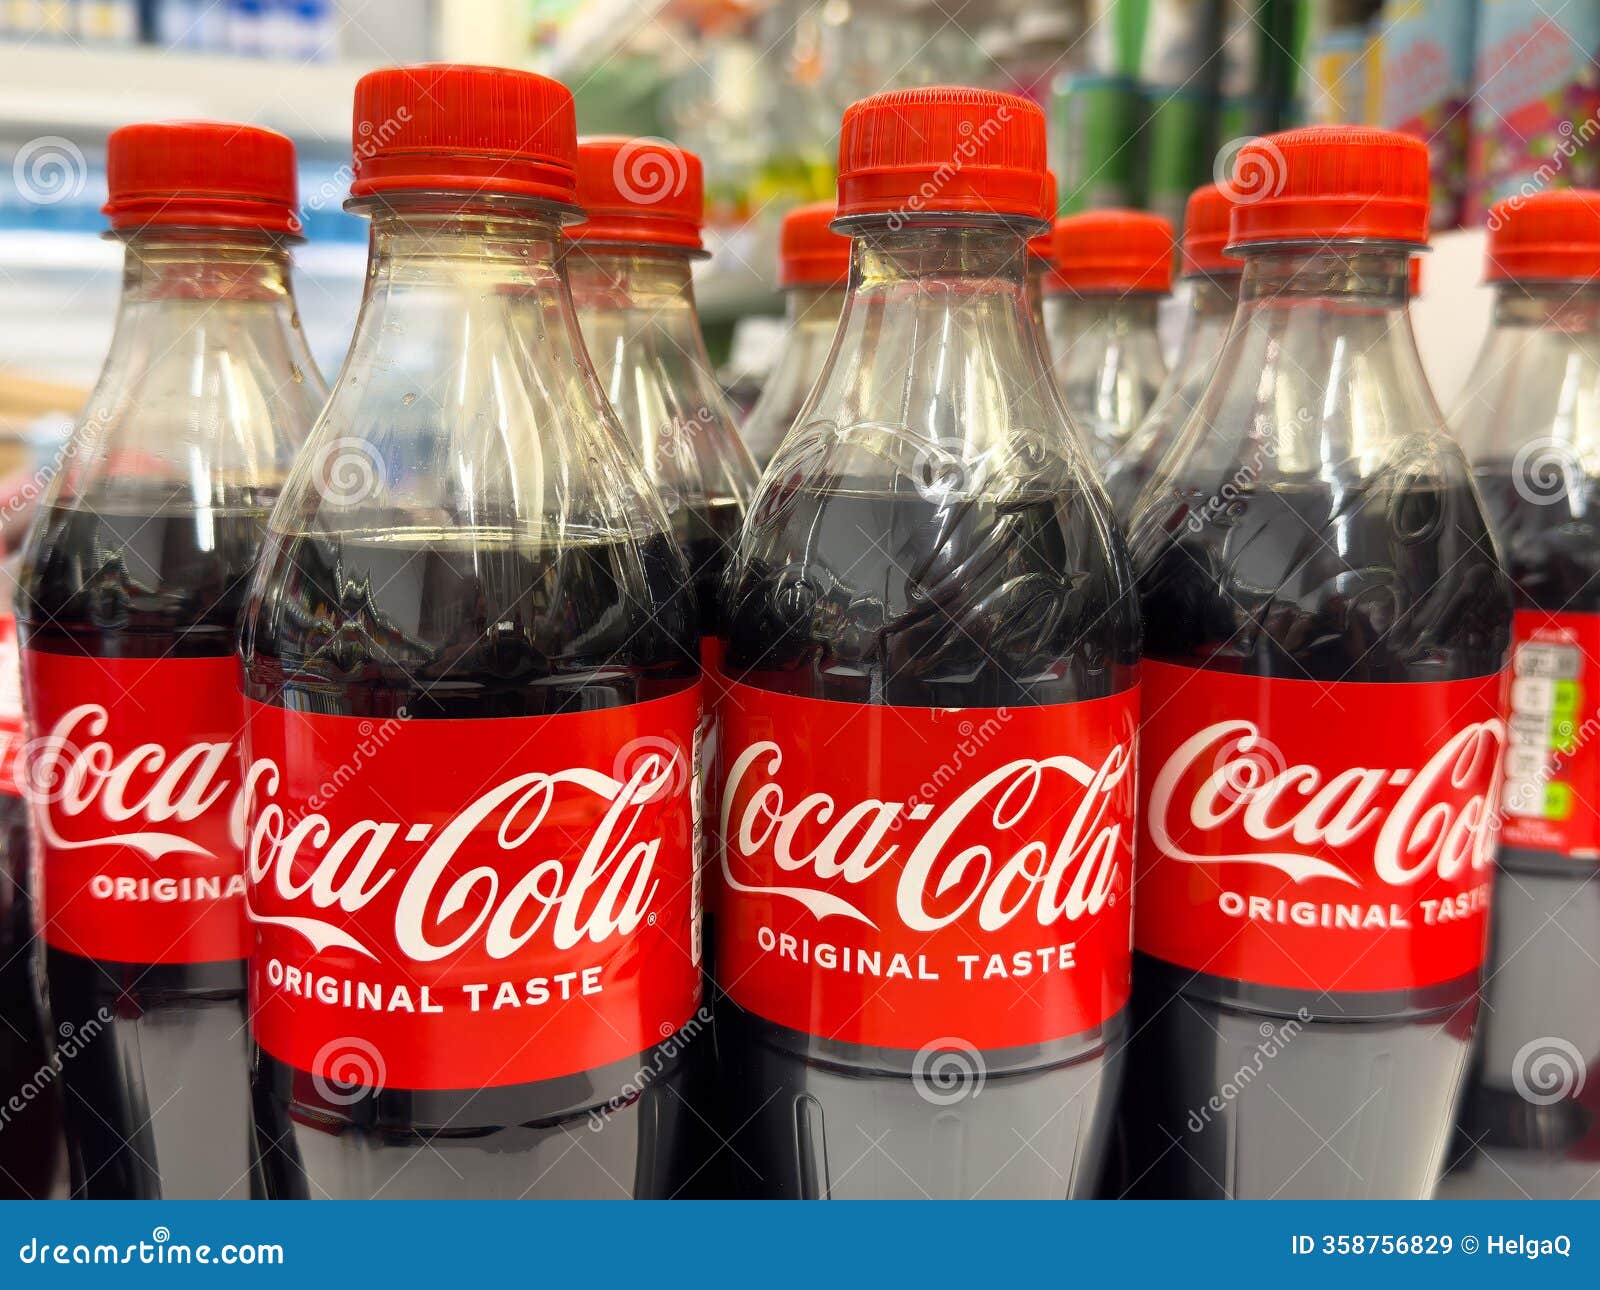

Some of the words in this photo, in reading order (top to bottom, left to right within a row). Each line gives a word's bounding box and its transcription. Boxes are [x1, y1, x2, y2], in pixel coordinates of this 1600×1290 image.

[39, 703, 245, 861] Coca
[720, 735, 1134, 932] Coca-Cola
[1148, 717, 1504, 888] Coca-Col
[90, 874, 246, 901] ORIGINA
[246, 745, 681, 962] Coca-Cola
[757, 926, 939, 980] ORIGINAL
[957, 942, 1076, 981] TASTE
[1218, 891, 1411, 929] ORIGINAL
[267, 958, 443, 1014] ORIGINAL
[463, 966, 603, 1012] TASTE
